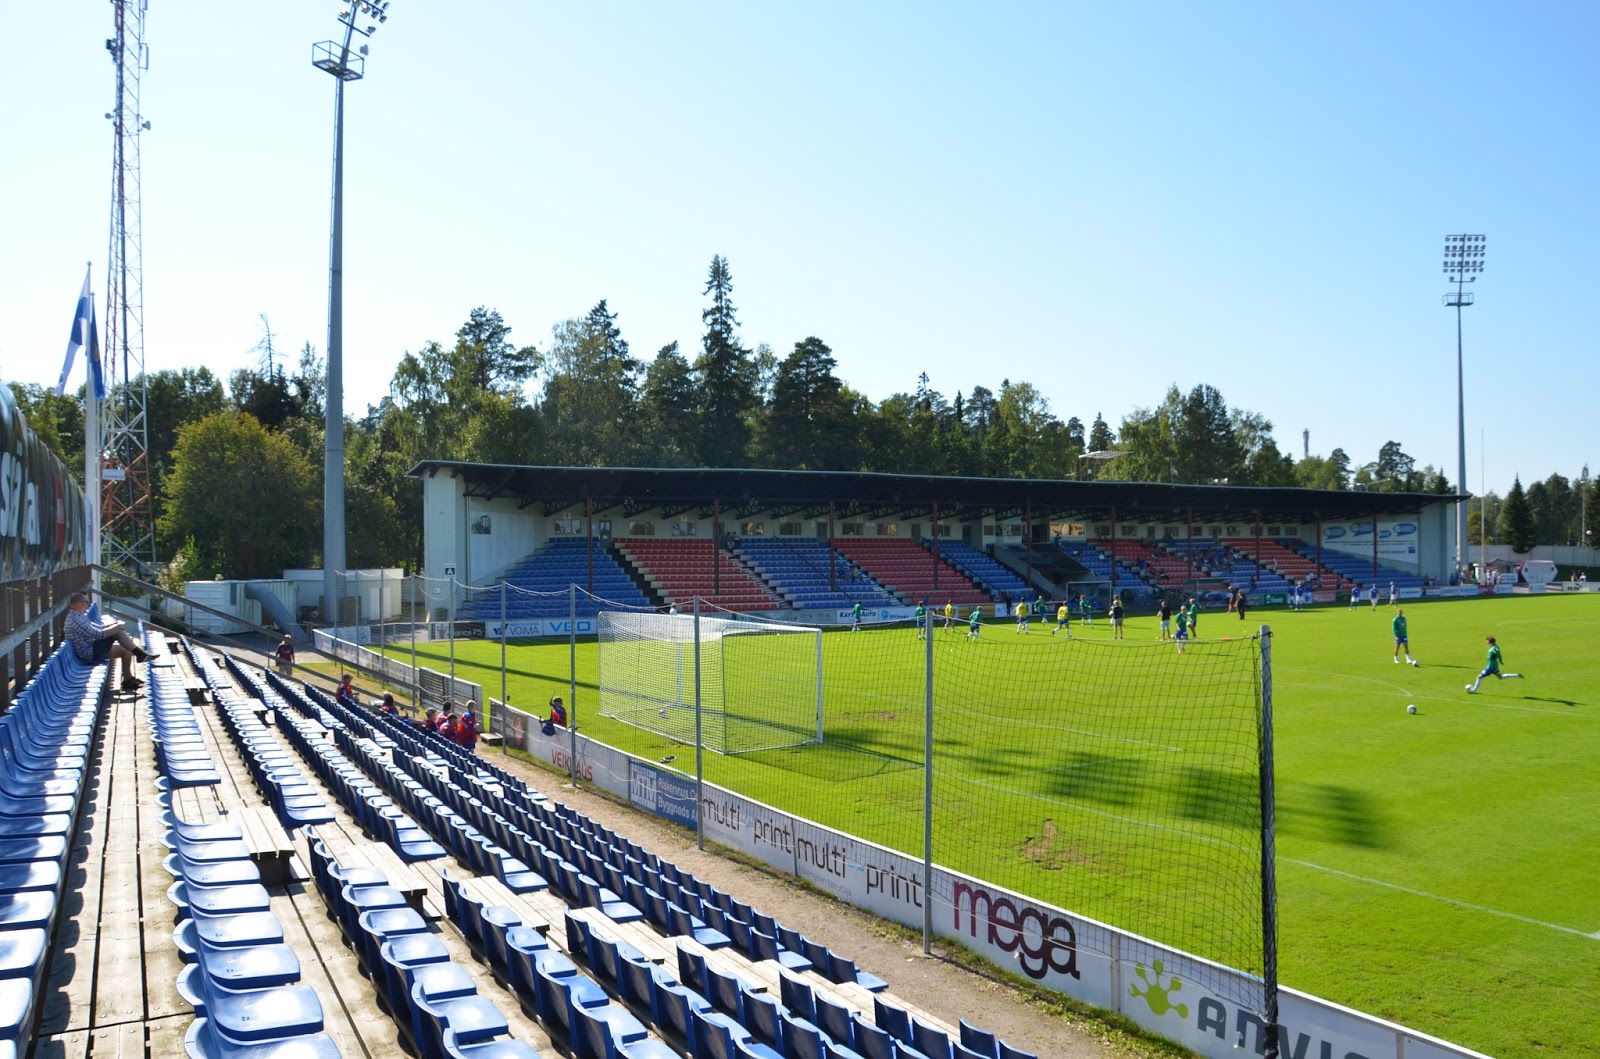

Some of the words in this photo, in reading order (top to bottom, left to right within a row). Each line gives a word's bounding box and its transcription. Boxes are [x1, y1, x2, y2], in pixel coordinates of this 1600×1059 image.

[509, 626, 539, 635] VOIMA
[631, 771, 657, 803] MTM
[658, 796, 690, 819] Byggnads
[703, 798, 740, 831] multi
[754, 817, 792, 854] print
[797, 838, 846, 879] multi
[866, 863, 923, 908] print
[953, 880, 1081, 981] mega
[1197, 996, 1370, 1059] ANV
